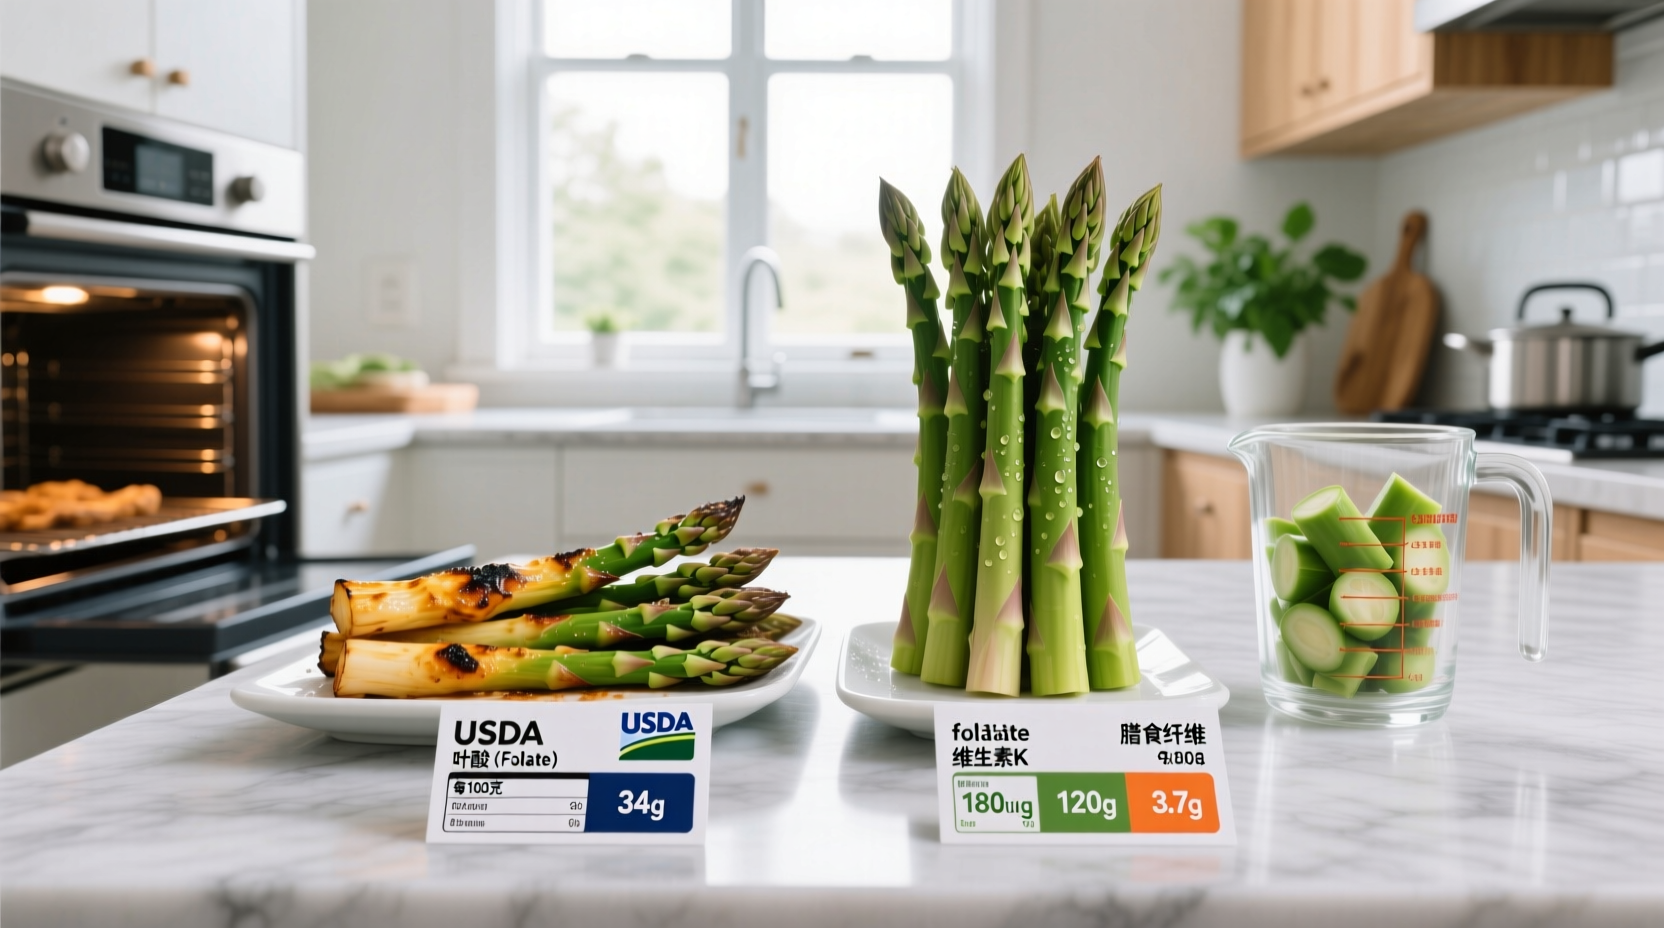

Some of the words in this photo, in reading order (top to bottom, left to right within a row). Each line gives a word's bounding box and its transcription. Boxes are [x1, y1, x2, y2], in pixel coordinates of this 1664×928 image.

[454, 720, 544, 746] USDA
[621, 712, 694, 734] USDA
[453, 749, 490, 769] 叶酸
[494, 750, 558, 769] (Folate)
[952, 746, 1029, 769] 维生素K
[617, 790, 665, 821] 34g
[1056, 789, 1117, 820] 120g
[1151, 789, 1203, 820] 3.7g
